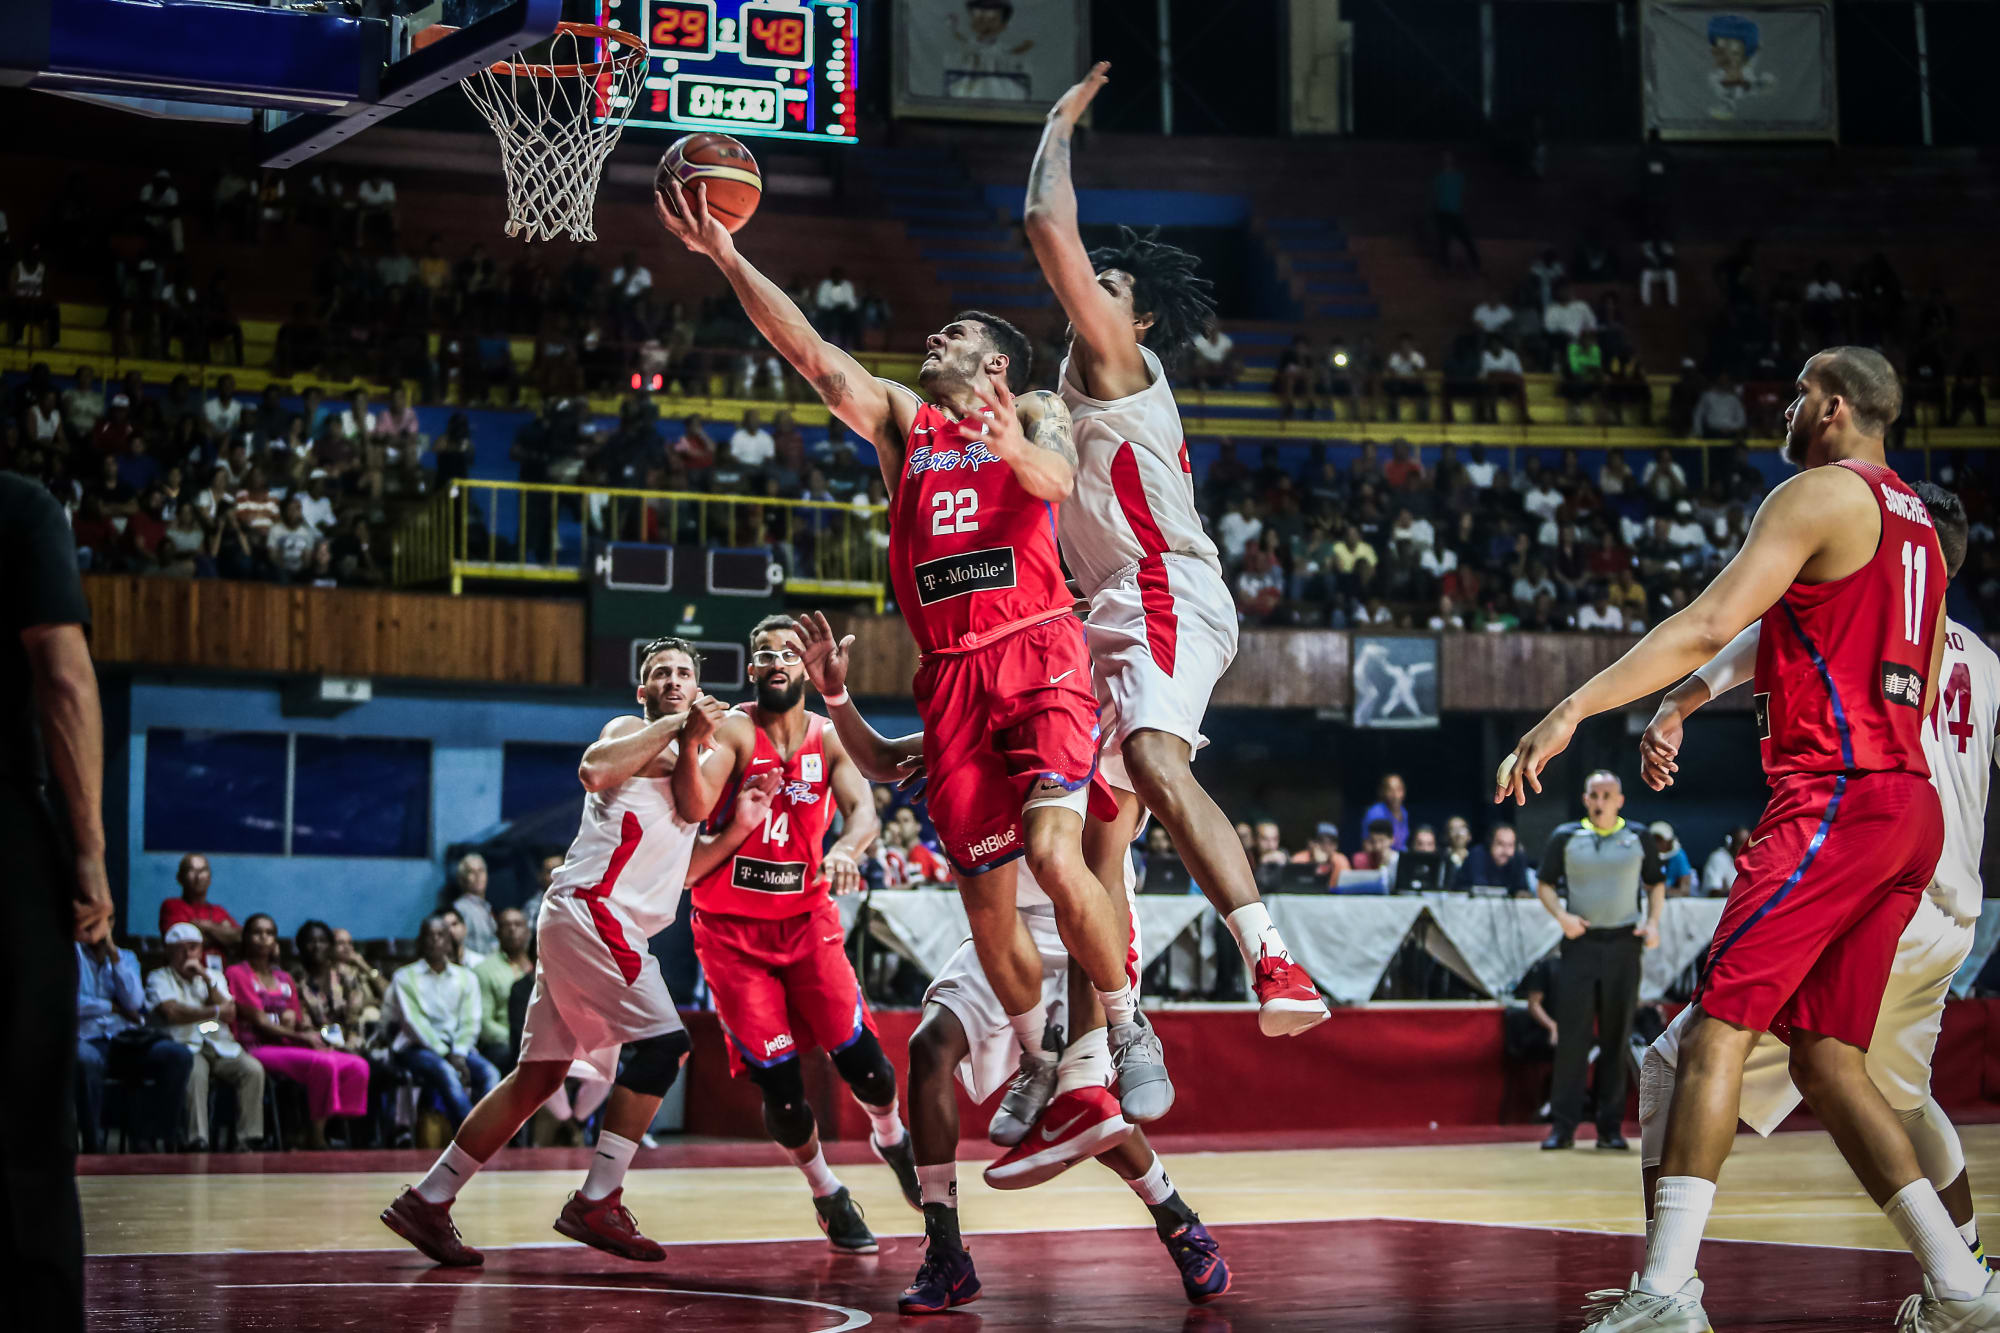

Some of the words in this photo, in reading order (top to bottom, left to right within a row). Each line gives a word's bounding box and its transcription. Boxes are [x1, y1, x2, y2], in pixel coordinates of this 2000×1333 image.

[652, 8, 708, 48] 29
[752, 17, 803, 55] 48
[931, 488, 980, 536] 22
[1901, 540, 1928, 646] 11
[762, 809, 790, 847] 14
[967, 827, 1017, 862] jetBlue
